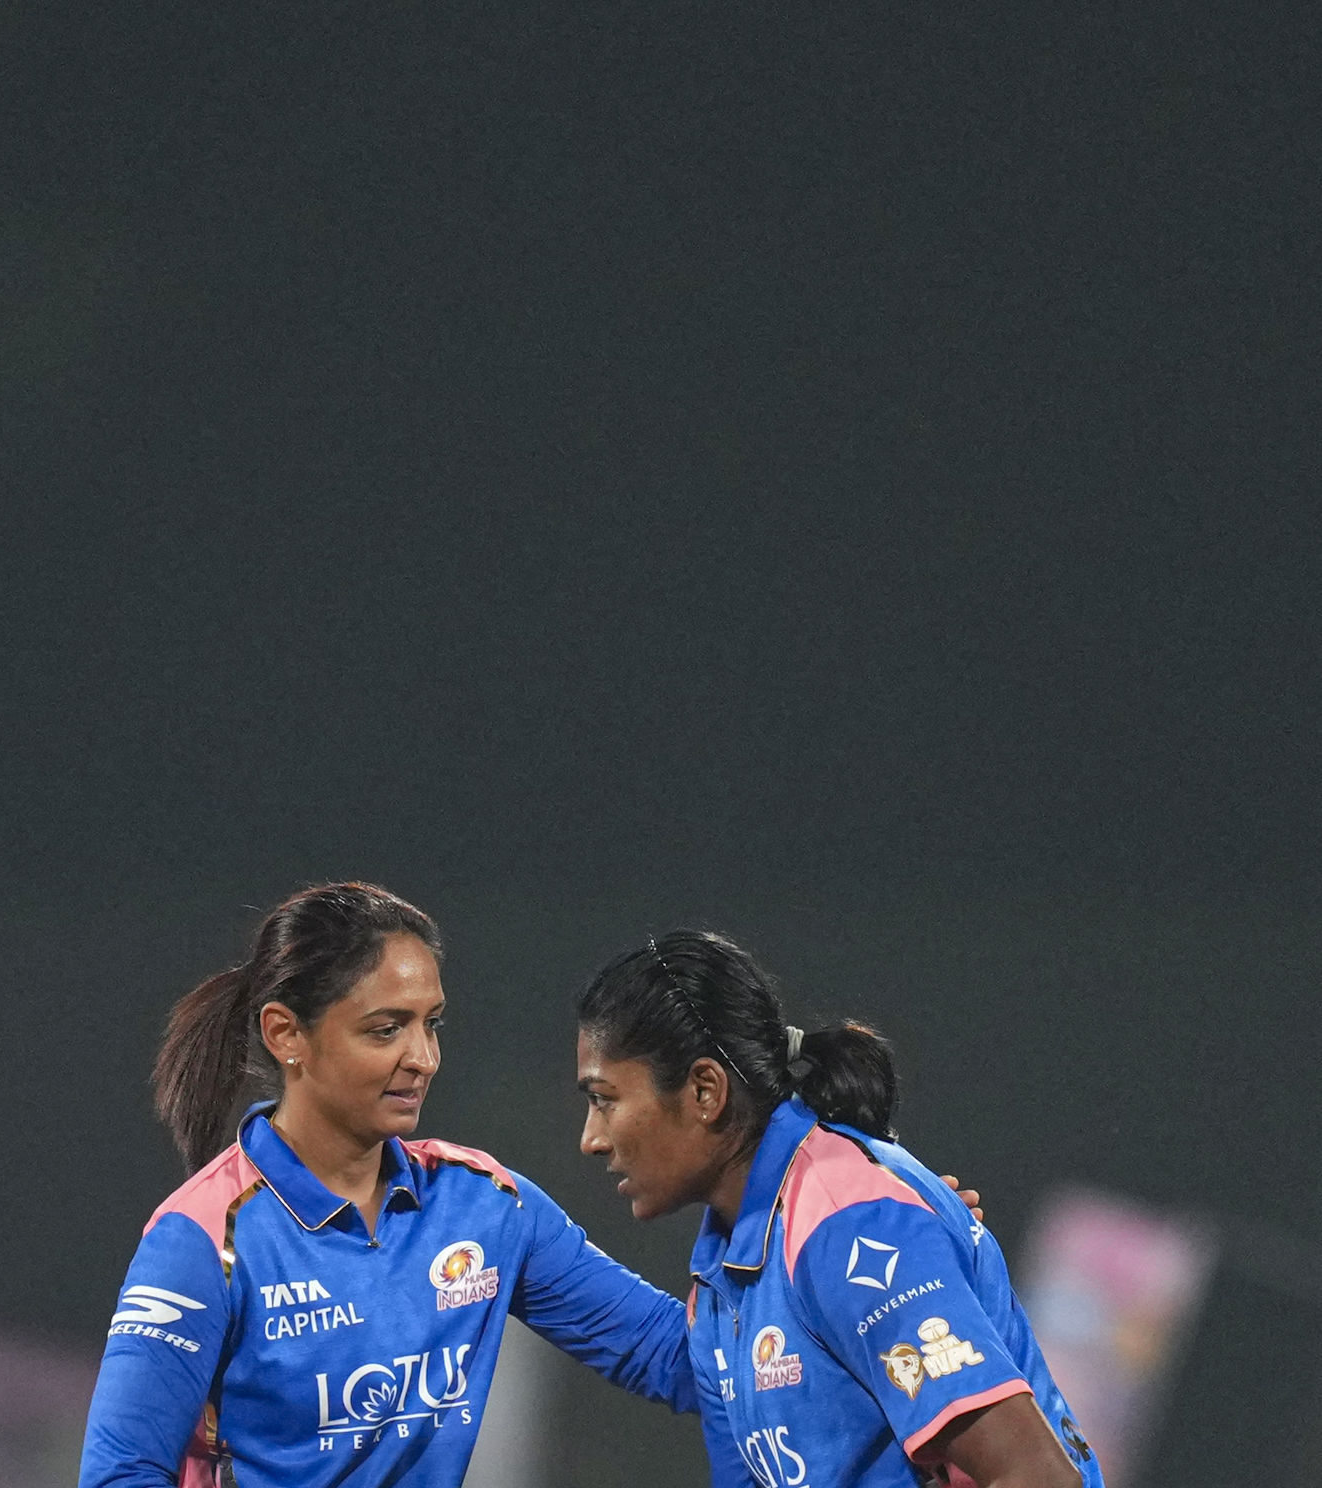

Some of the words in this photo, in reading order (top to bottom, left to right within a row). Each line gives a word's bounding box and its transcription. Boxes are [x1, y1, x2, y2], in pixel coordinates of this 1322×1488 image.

[259, 1279, 332, 1309] TATA
[438, 1281, 497, 1309] INDIANS
[265, 1303, 365, 1341] CAPITAL
[108, 1323, 202, 1353] KECHERS
[316, 1344, 471, 1427] LOTUS
